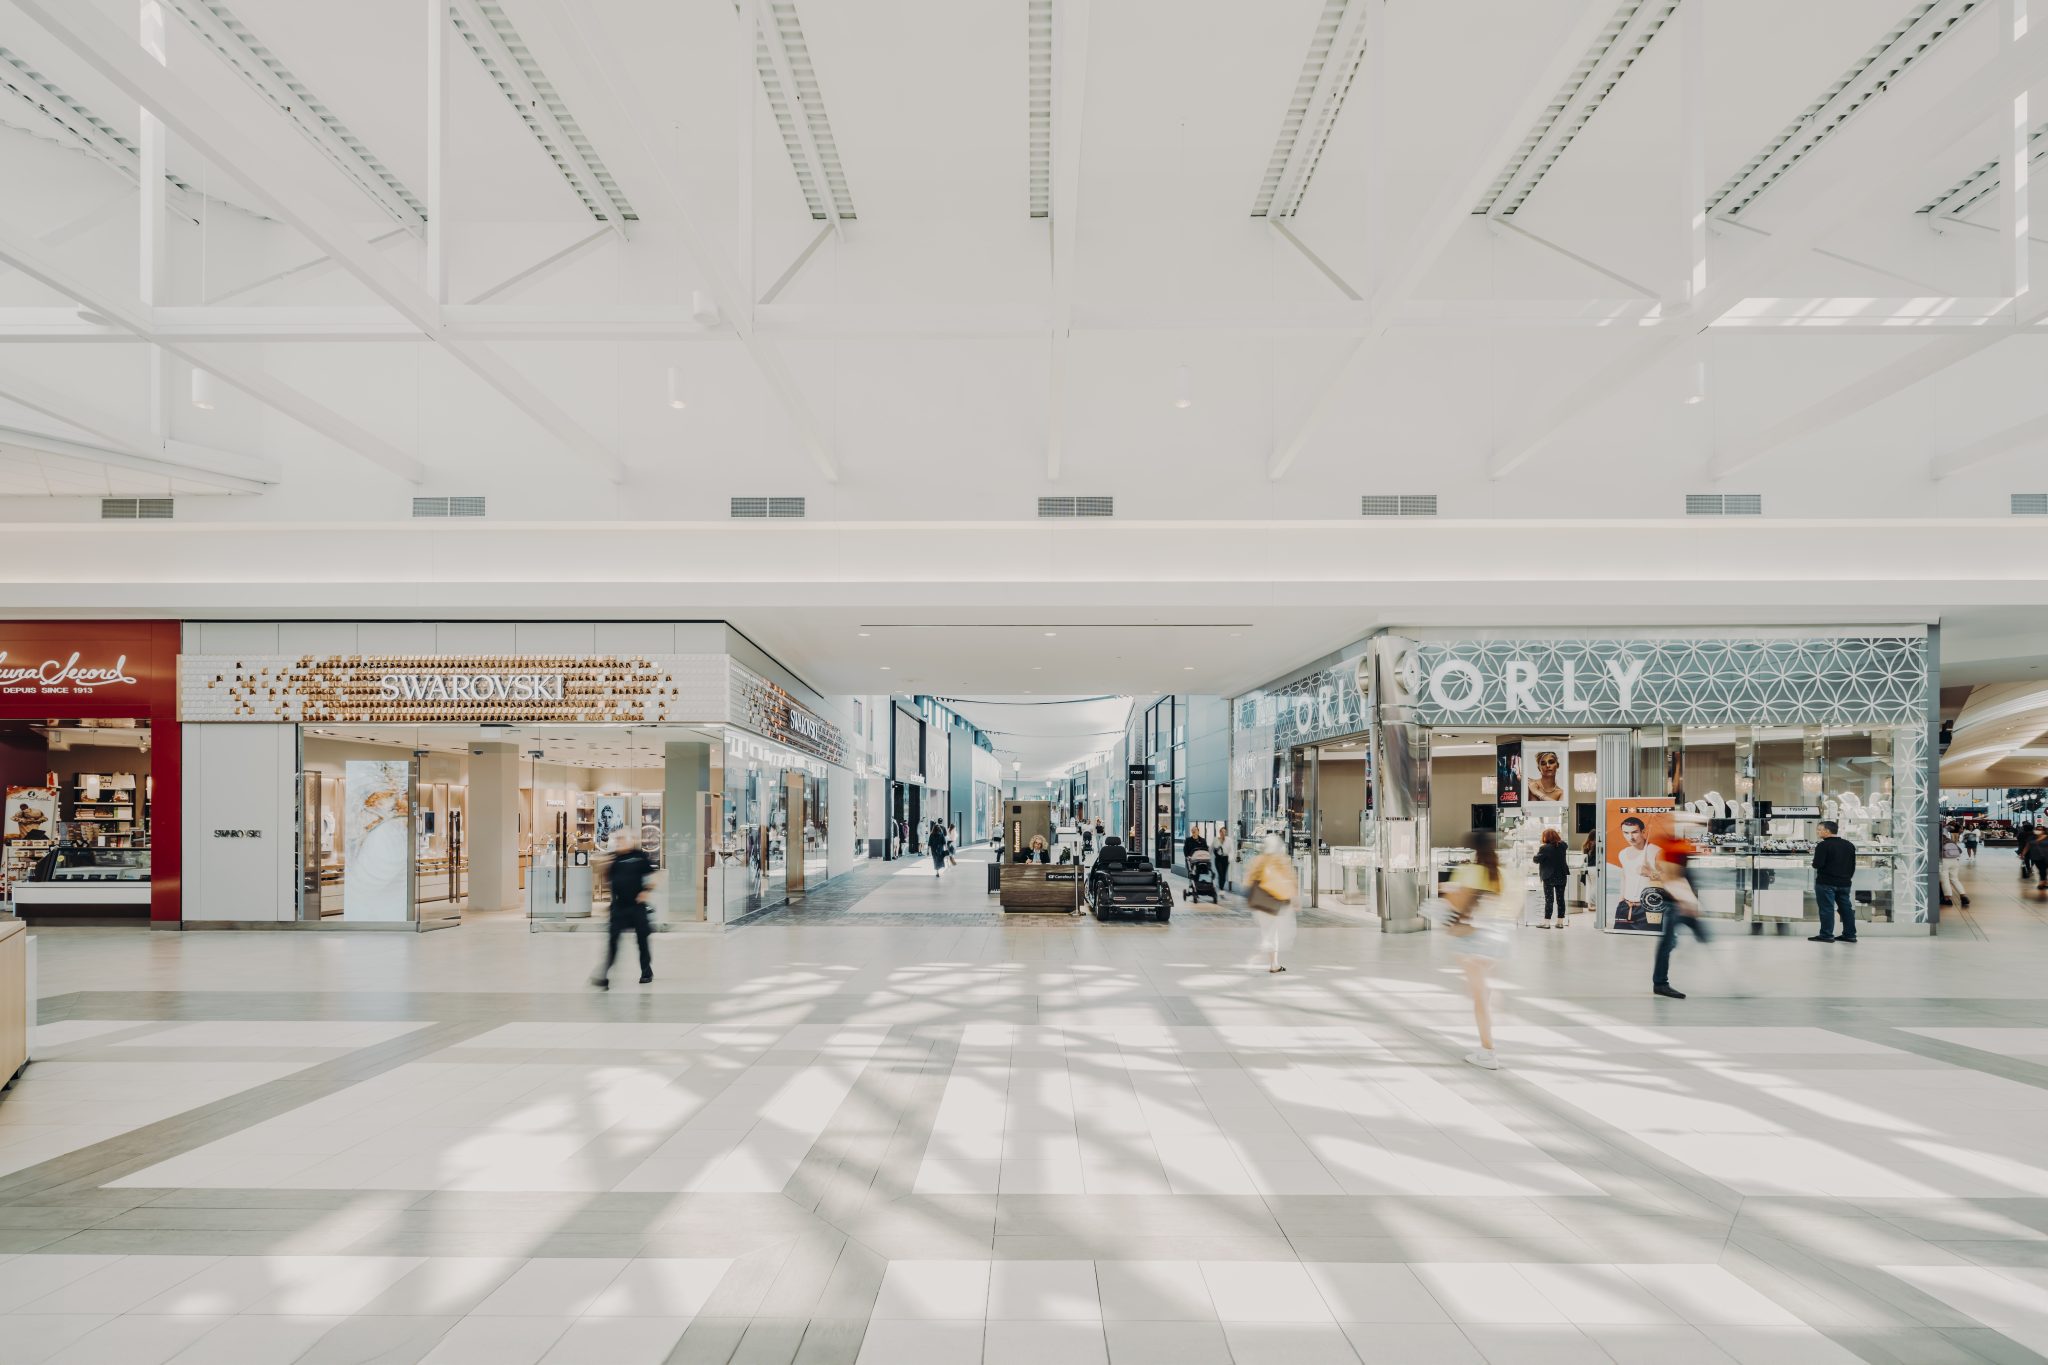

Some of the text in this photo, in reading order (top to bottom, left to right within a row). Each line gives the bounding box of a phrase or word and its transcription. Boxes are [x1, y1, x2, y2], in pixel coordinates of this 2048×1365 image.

[39, 651, 137, 686] Secord
[1429, 659, 1646, 712] ORLY
[381, 674, 564, 701] SWAROVSKI
